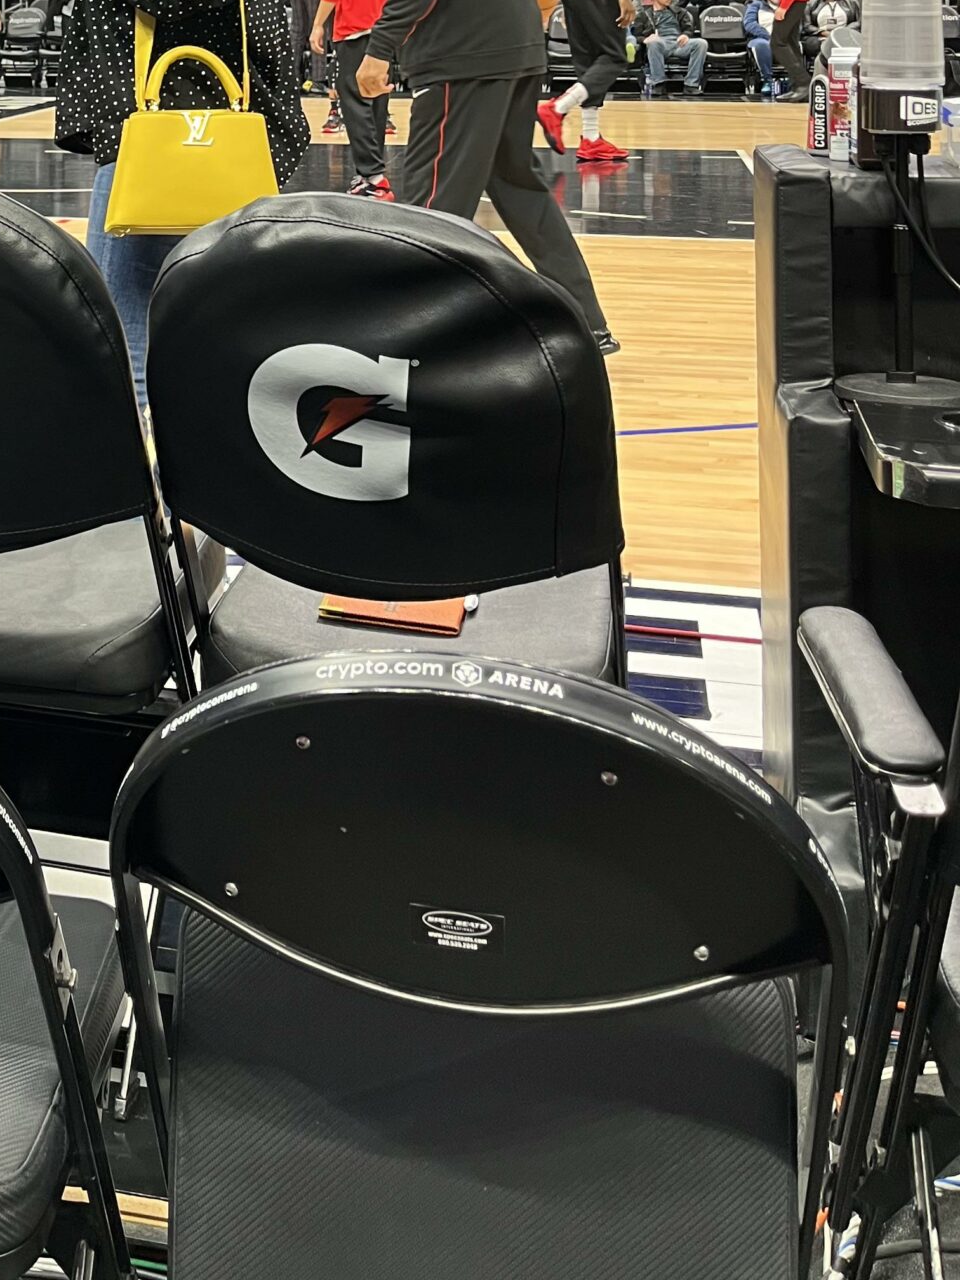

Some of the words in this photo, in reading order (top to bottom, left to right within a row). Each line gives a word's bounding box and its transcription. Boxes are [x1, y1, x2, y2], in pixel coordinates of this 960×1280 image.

[704, 15, 743, 23] Aspiration
[815, 84, 826, 111] GRIP
[912, 101, 937, 115] OES
[814, 113, 826, 148] COURT
[247, 344, 410, 501] G
[315, 658, 444, 681] crypto.com
[487, 671, 565, 700] ARENA
[630, 710, 774, 806] www.cryptoarena.com
